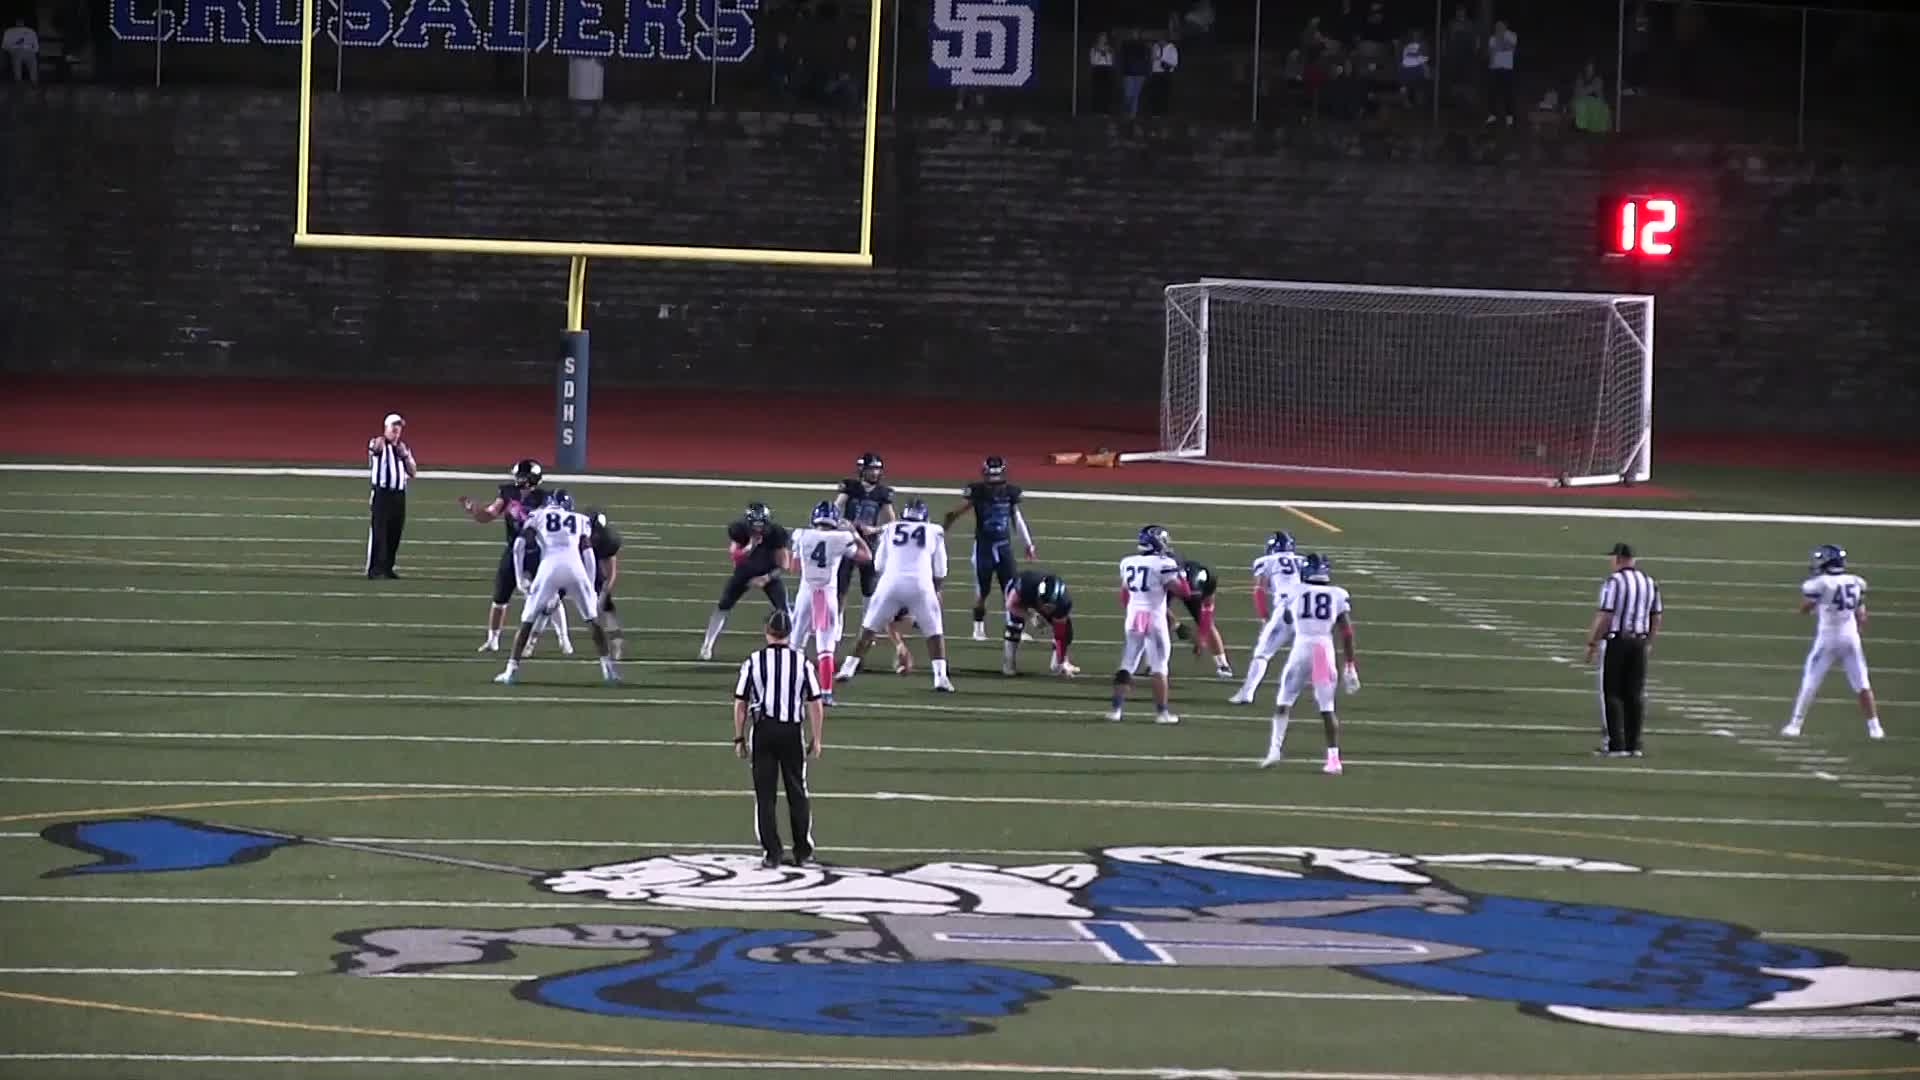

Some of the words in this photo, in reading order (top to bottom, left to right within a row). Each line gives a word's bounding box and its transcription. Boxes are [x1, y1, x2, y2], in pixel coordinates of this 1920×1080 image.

[1622, 200, 1677, 255] 12
[562, 356, 577, 446] SDHS
[545, 512, 577, 535] 84
[892, 523, 927, 549] 54
[810, 540, 828, 569] 4
[1126, 565, 1152, 593] 27
[1301, 590, 1332, 620] 18
[1832, 583, 1858, 612] 45
